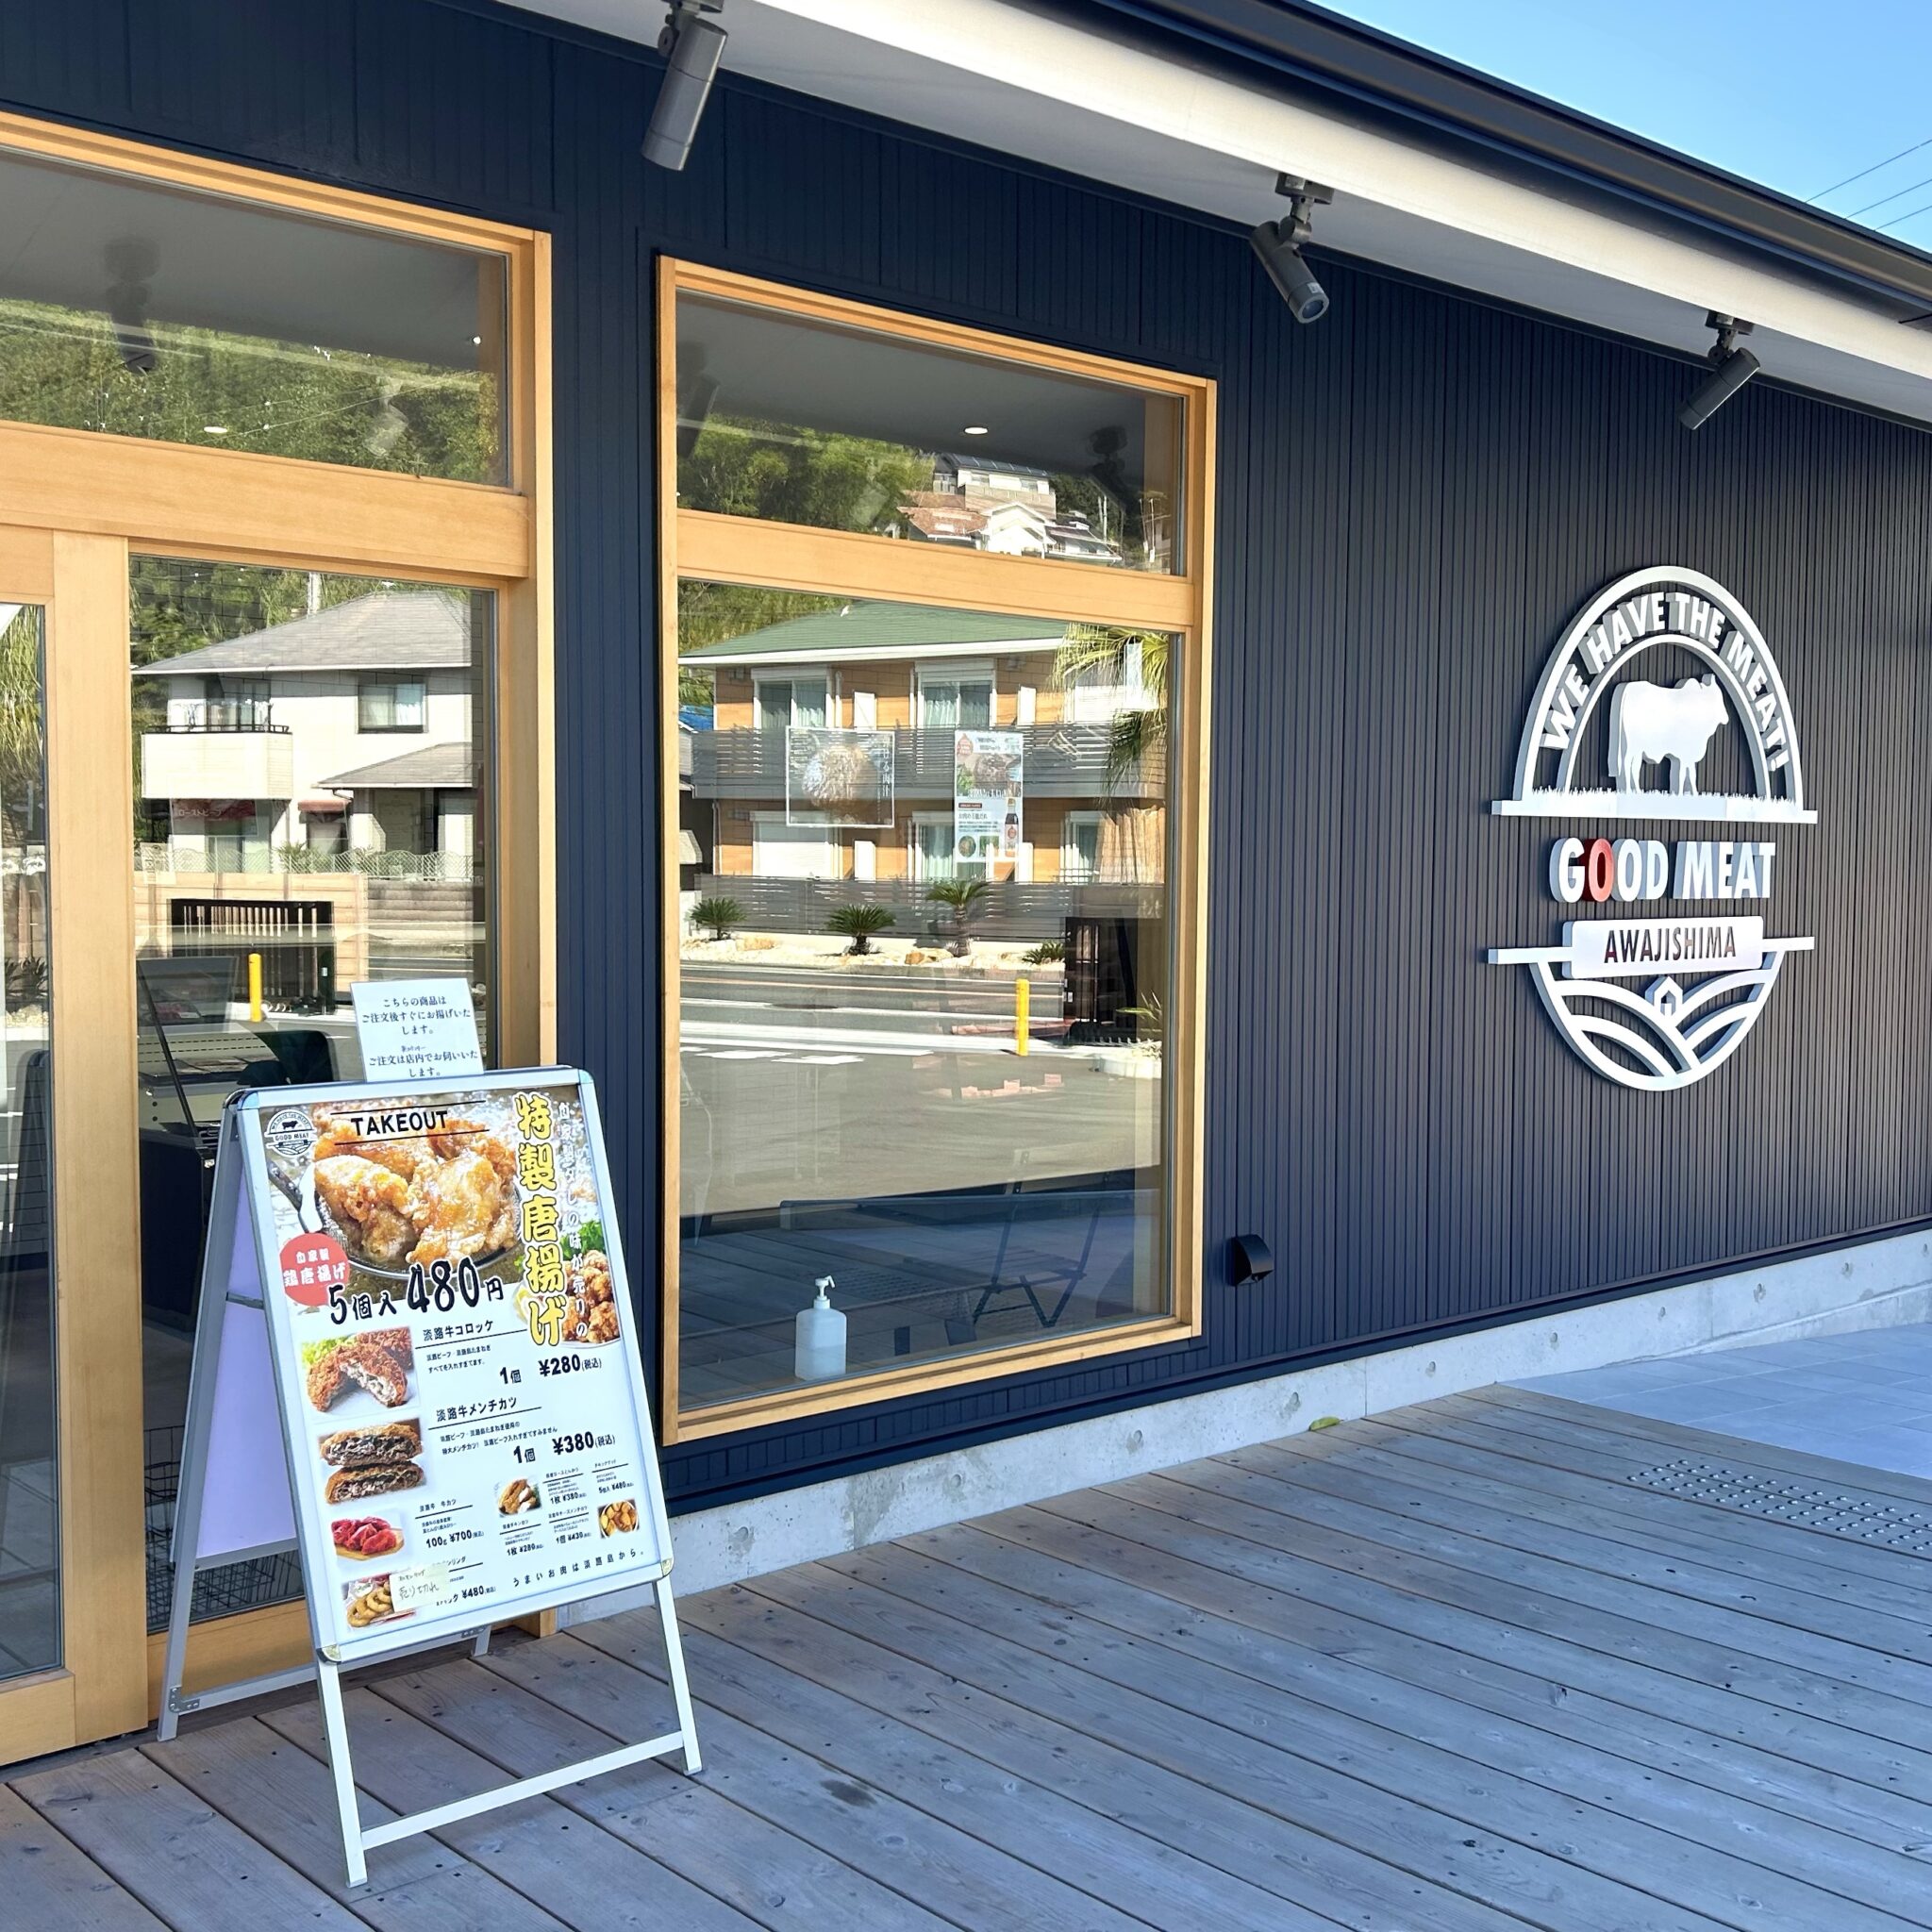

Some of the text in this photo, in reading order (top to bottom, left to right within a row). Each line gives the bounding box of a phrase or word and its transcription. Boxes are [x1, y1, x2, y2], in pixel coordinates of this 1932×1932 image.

[1541, 591, 1790, 772] WE HAVE THE MEAT!
[1555, 838, 1776, 903] GOOD MEAT
[1604, 925, 1737, 964] AWAJISHIMA
[383, 996, 447, 1008] こちらの商品は
[362, 1008, 472, 1024] ご注文後すぐにお揚げいた
[401, 1024, 434, 1035] します。
[408, 1067, 441, 1077] します。
[351, 1110, 448, 1136] TAKEOUT
[514, 1092, 567, 1347] 特製唐揚げ
[423, 1320, 494, 1341] 淡路牛コロッケ
[436, 1396, 517, 1422] 淡路牛メンチカツ
